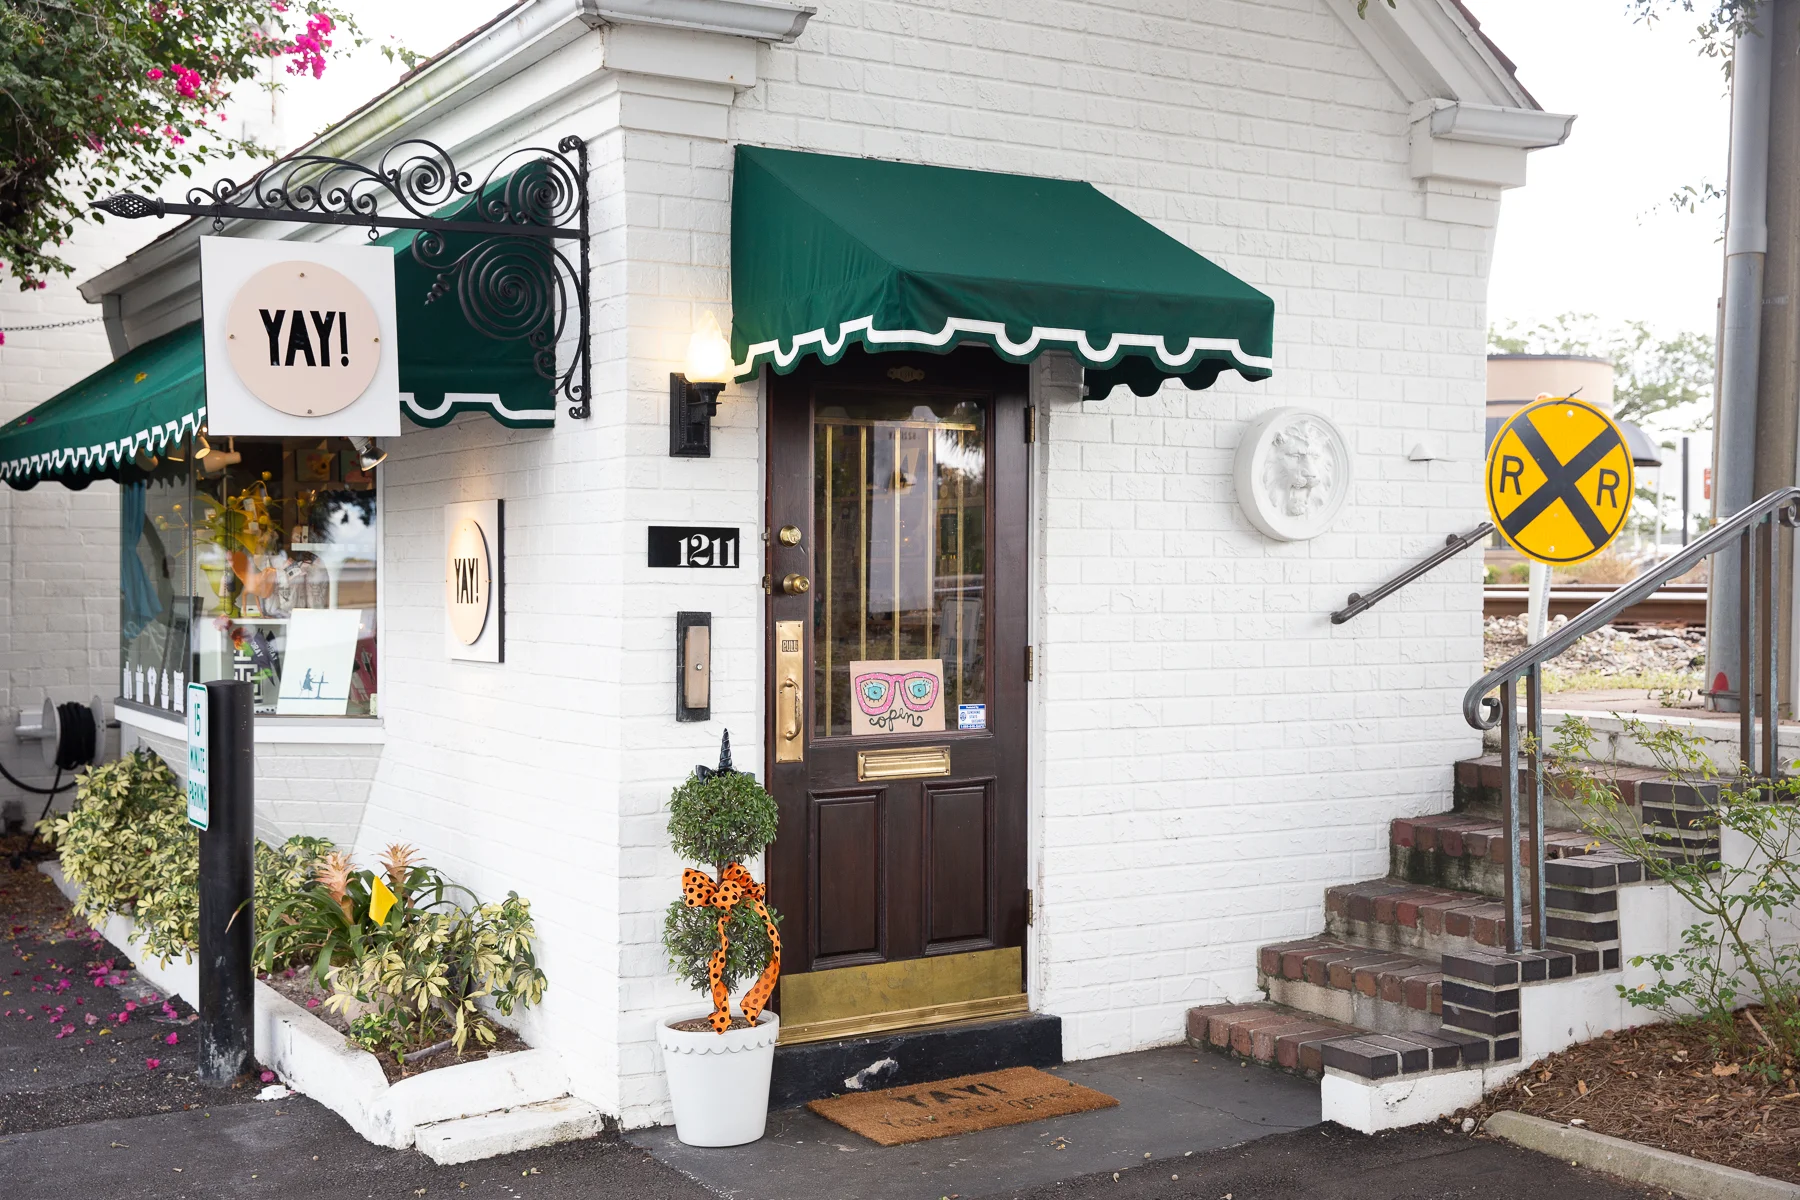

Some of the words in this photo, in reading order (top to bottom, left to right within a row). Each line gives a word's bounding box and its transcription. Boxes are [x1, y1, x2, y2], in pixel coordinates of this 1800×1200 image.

[259, 309, 349, 367] YAY!
[1499, 455, 1524, 496] R
[1596, 468, 1620, 508] R
[677, 534, 736, 567] 1211
[454, 558, 479, 604] YAY!
[782, 640, 798, 652] PULL
[194, 703, 201, 737] 15
[190, 745, 205, 774] MINUTE
[188, 780, 207, 811] PARKING
[890, 1083, 1008, 1109] YAY!
